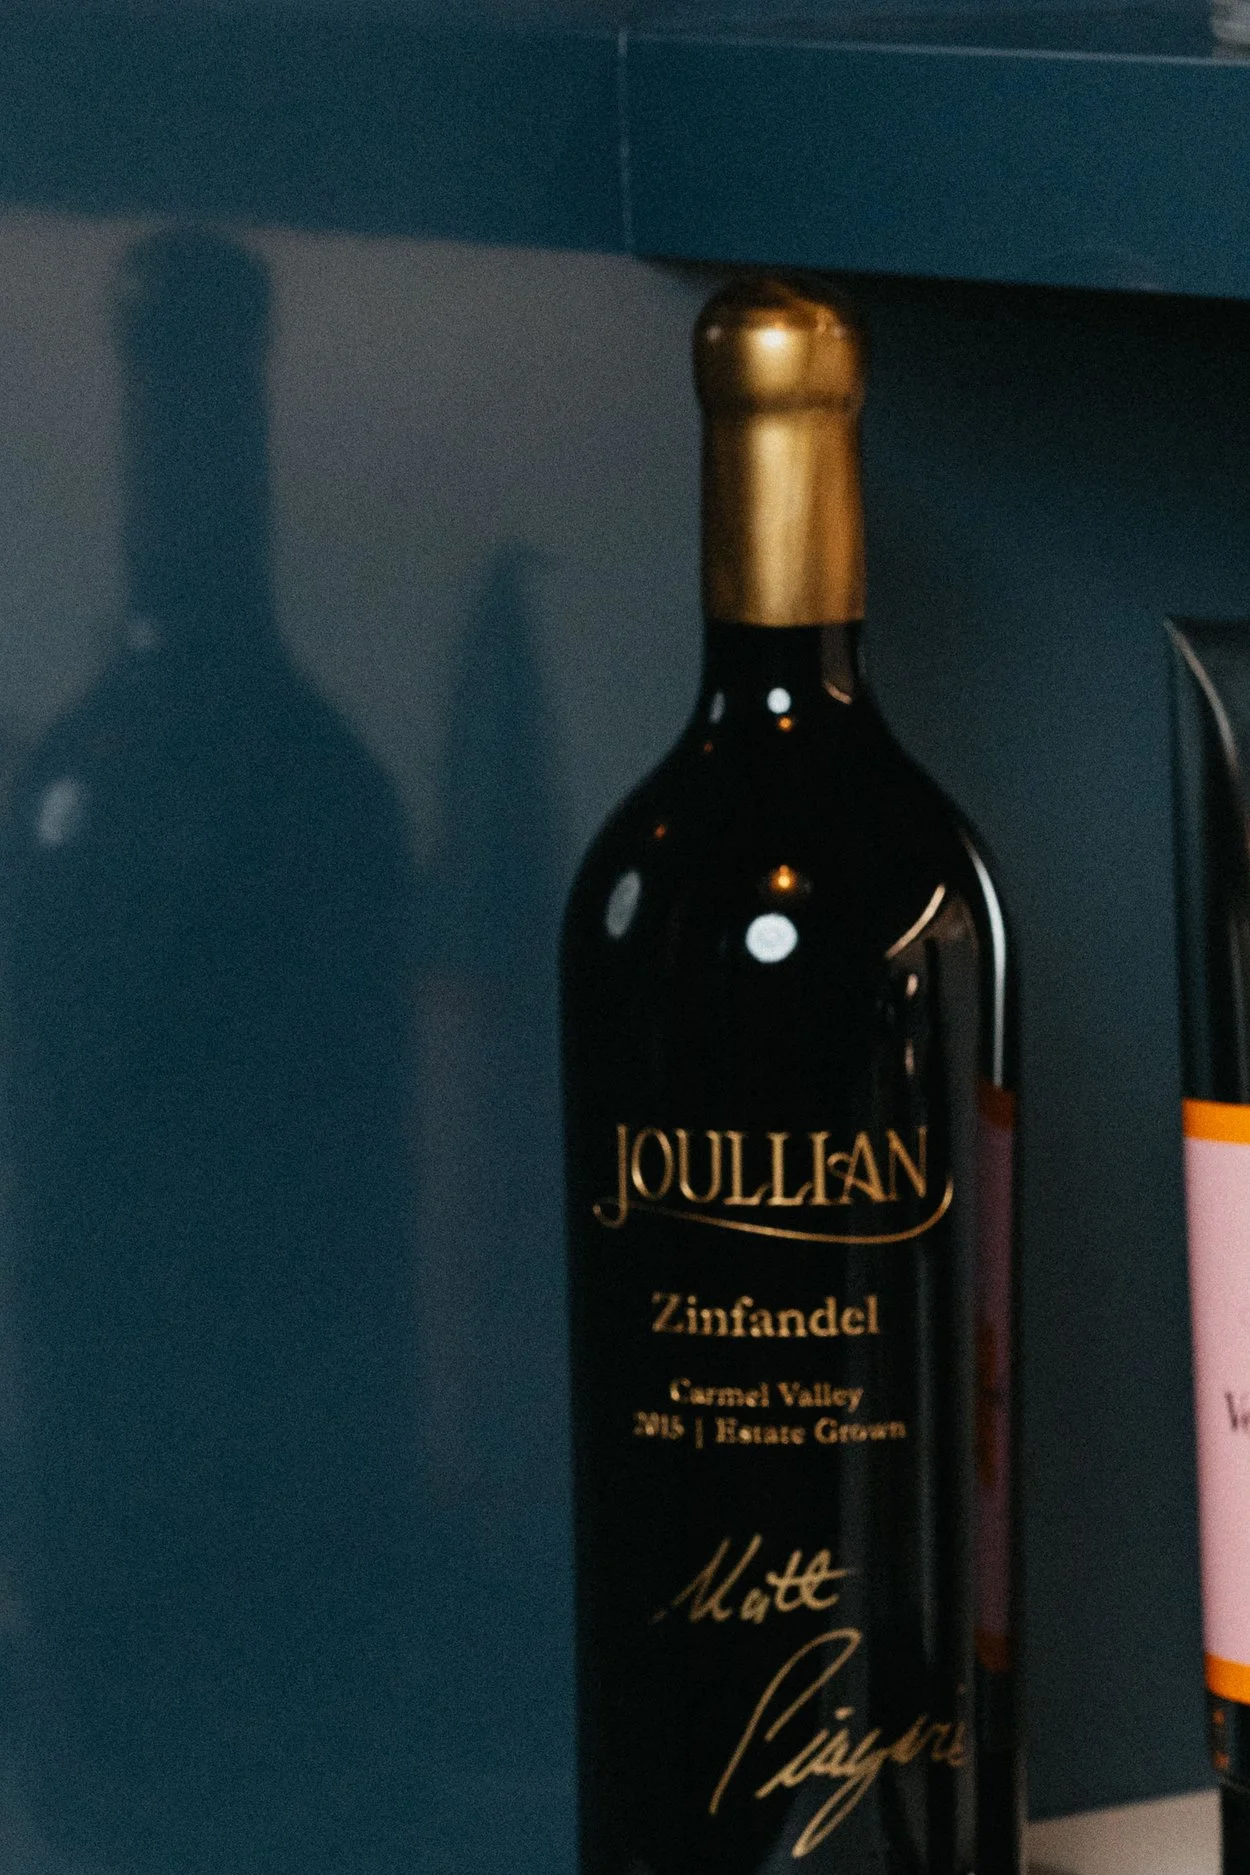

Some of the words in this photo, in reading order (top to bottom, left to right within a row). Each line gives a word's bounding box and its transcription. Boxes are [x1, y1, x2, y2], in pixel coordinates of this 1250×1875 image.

[592, 1123, 928, 1228] JOULLIAN
[651, 1291, 880, 1338] Zinfandel
[669, 1377, 769, 1408] Carmel
[776, 1382, 864, 1413] Valley
[715, 1416, 806, 1445] Estate
[814, 1416, 907, 1444] Grown
